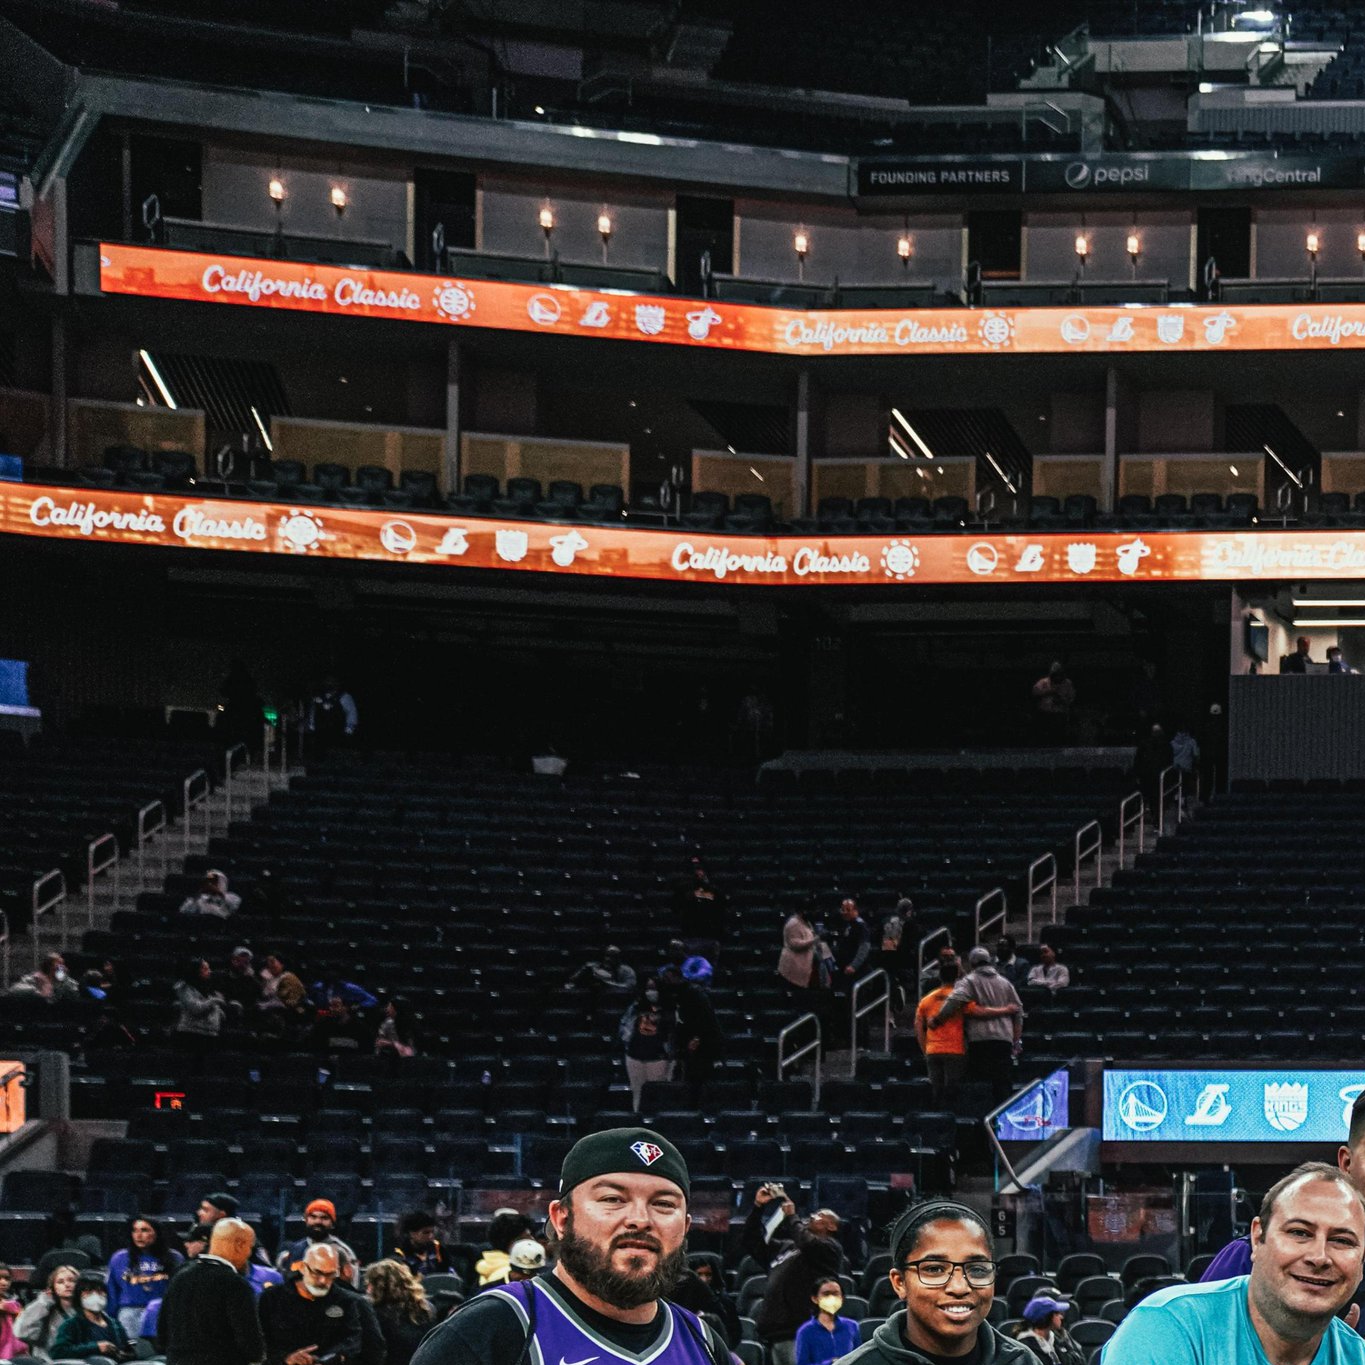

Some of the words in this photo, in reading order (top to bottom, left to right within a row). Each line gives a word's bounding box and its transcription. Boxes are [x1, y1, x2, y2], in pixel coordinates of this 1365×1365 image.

[870, 171, 937, 184] FOUNDING
[940, 170, 1011, 183] PARTNERS
[1094, 165, 1150, 186] pepsi
[202, 264, 327, 302] California
[334, 278, 421, 309] Classic
[784, 318, 889, 349] California
[894, 319, 968, 344] Classic
[30, 496, 166, 535] California
[172, 508, 266, 541] Classic
[671, 542, 788, 579] California
[793, 546, 870, 575] Classic
